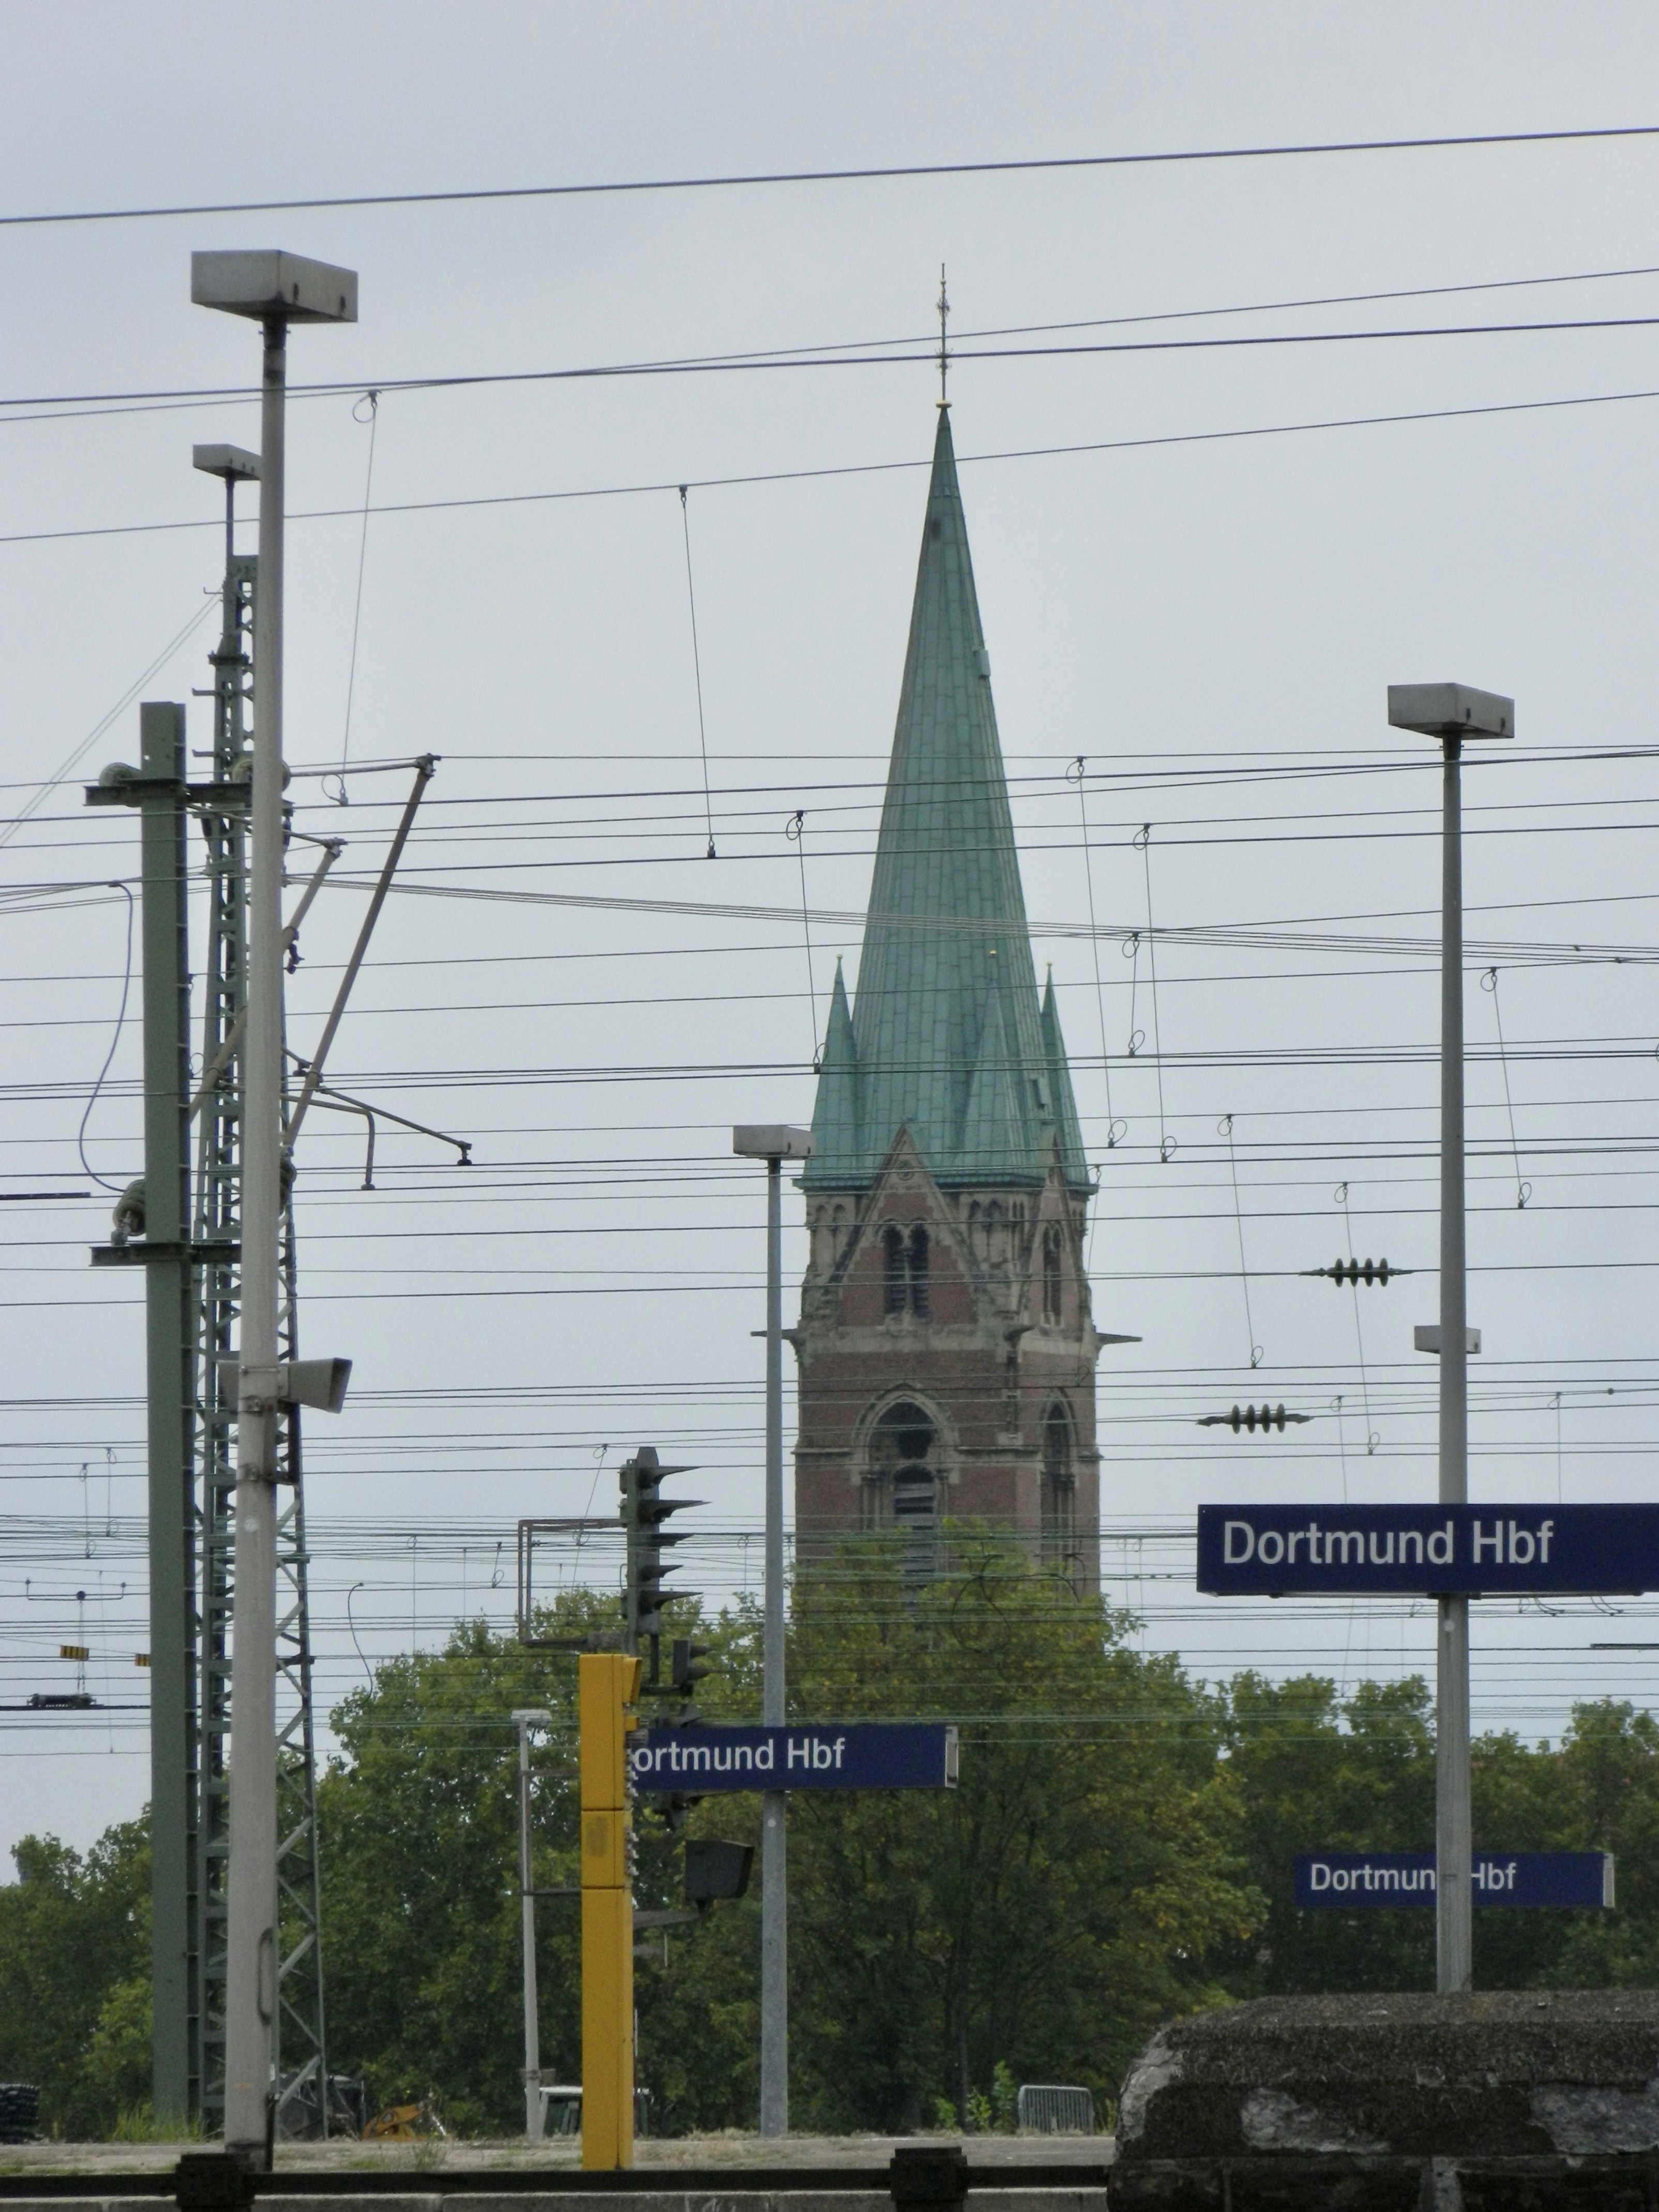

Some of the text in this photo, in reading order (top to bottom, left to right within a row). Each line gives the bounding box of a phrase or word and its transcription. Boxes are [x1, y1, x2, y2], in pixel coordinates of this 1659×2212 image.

[1224, 1520, 1554, 1564] Dortmund Hbf
[634, 1738, 845, 1771] ortmund Hbf
[1311, 1863, 1516, 1890] Dortmun Hbf
